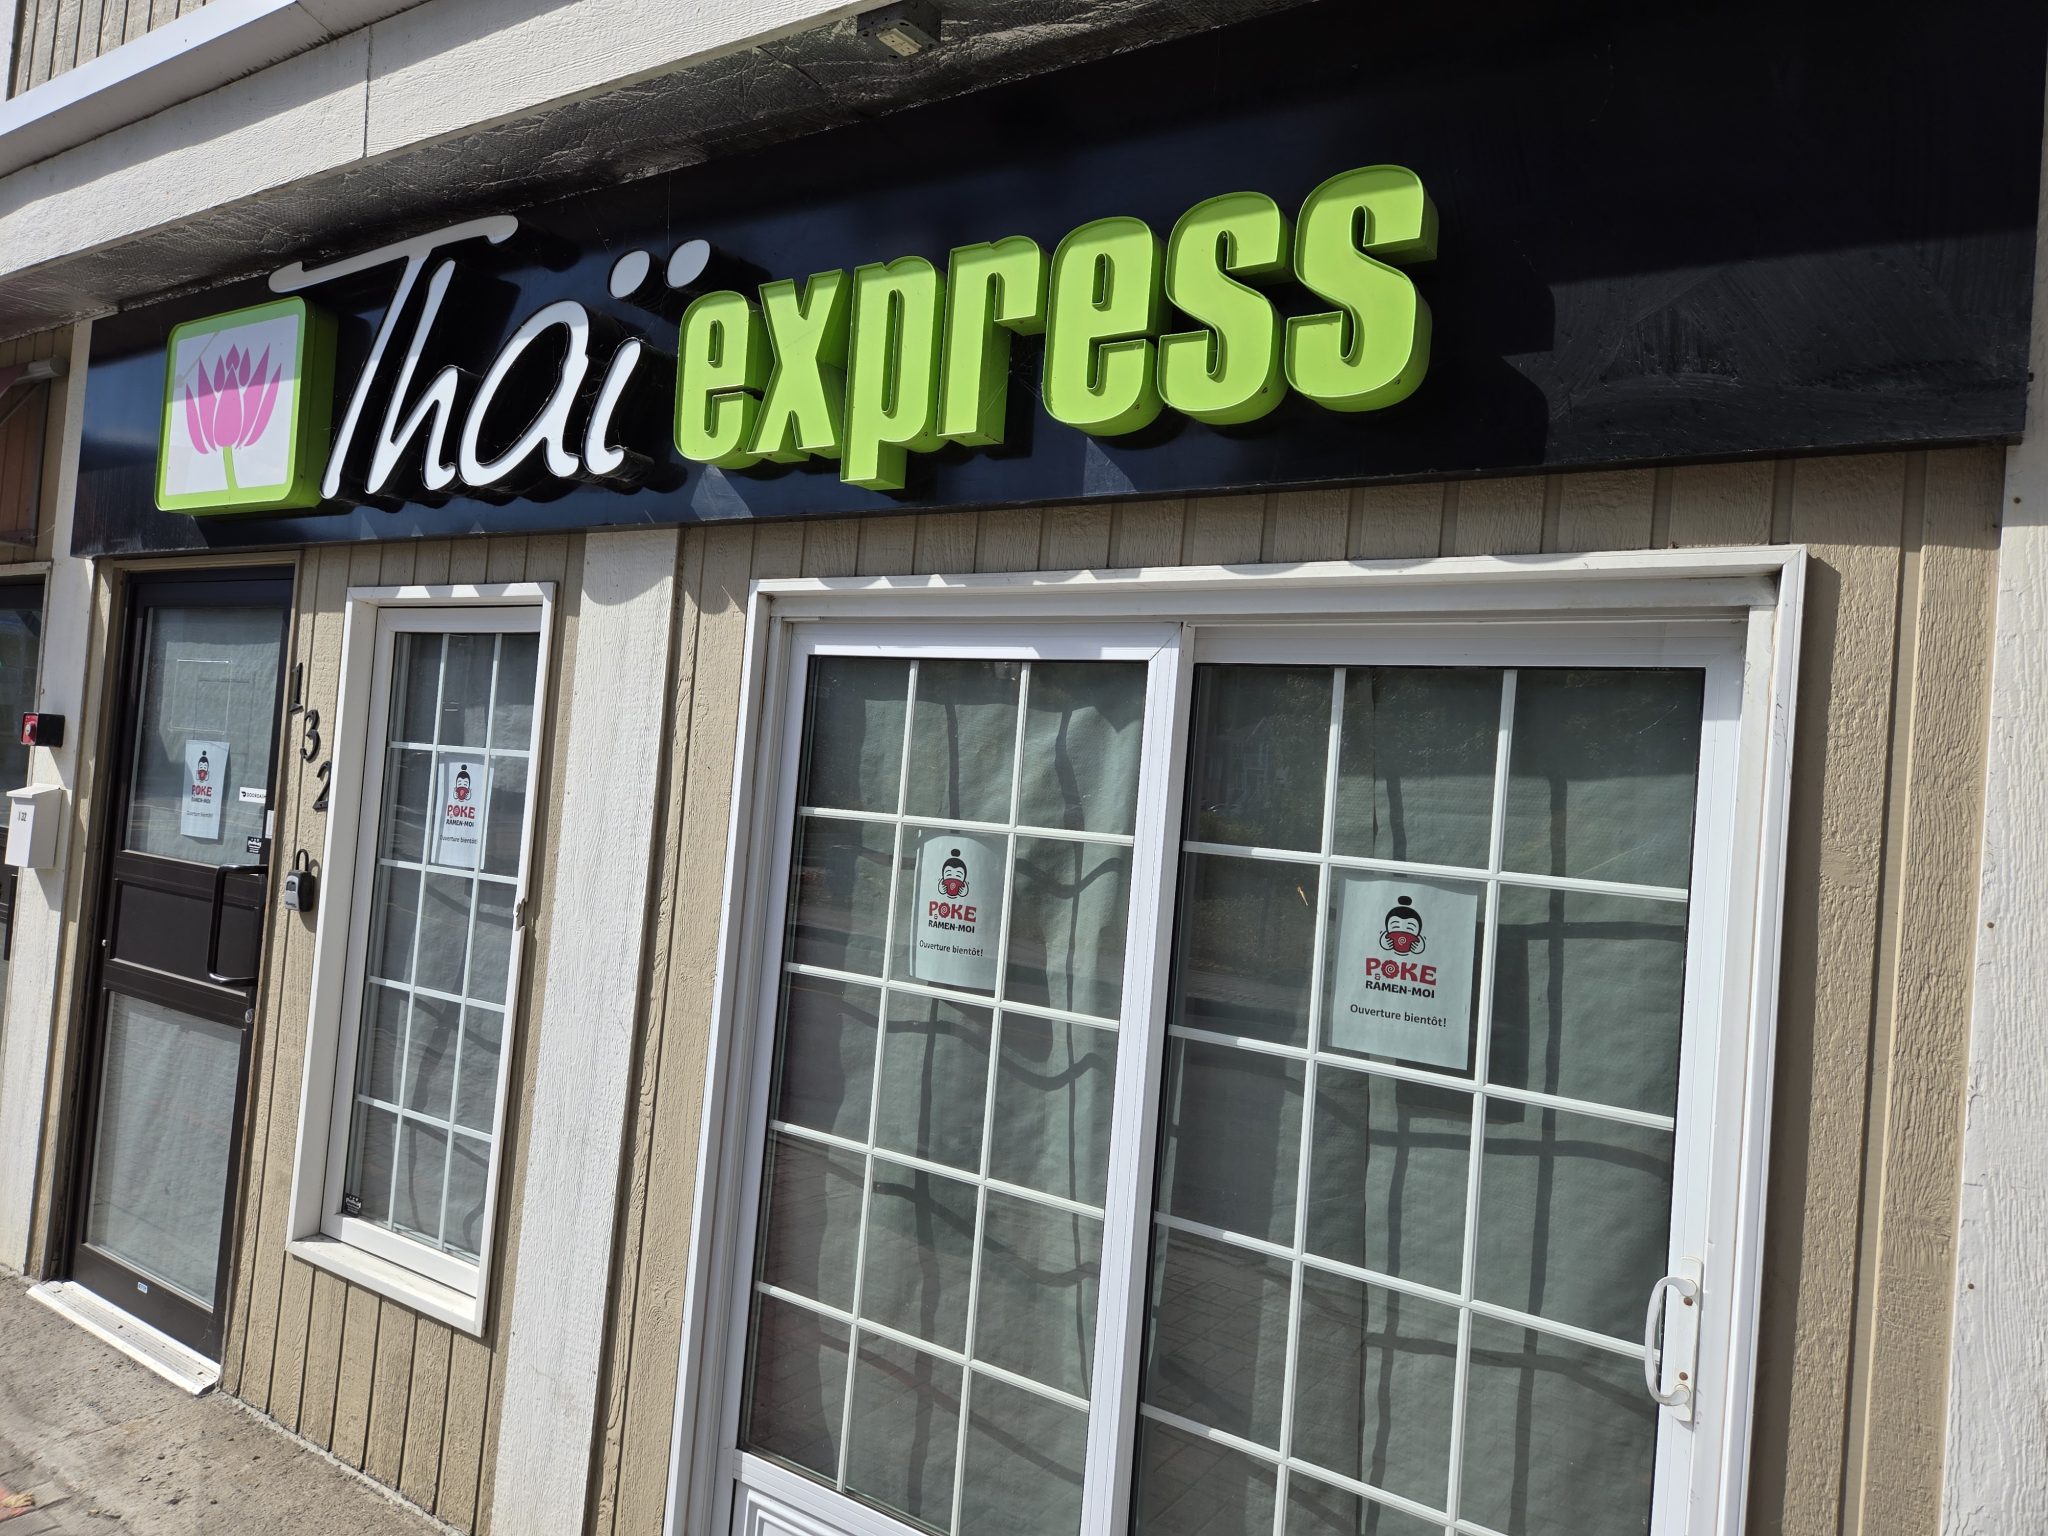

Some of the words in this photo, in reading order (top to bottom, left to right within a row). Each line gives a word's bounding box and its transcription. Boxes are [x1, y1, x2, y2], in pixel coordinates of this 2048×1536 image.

[268, 215, 710, 499] Thaï
[673, 164, 1438, 490] express
[191, 784, 213, 797] POKE
[447, 805, 475, 819] POKE
[446, 818, 475, 827] RAMEN-MOI
[928, 900, 977, 923] POKE
[928, 920, 975, 934] RAMEN-MOI
[919, 939, 951, 953] Ouverture
[951, 945, 984, 957] bientôt!
[1365, 957, 1437, 986] POKE
[1365, 979, 1435, 999] RAMEN-MOI
[1350, 1003, 1401, 1021] Ouverture
[1404, 1012, 1447, 1028] bientôt!
